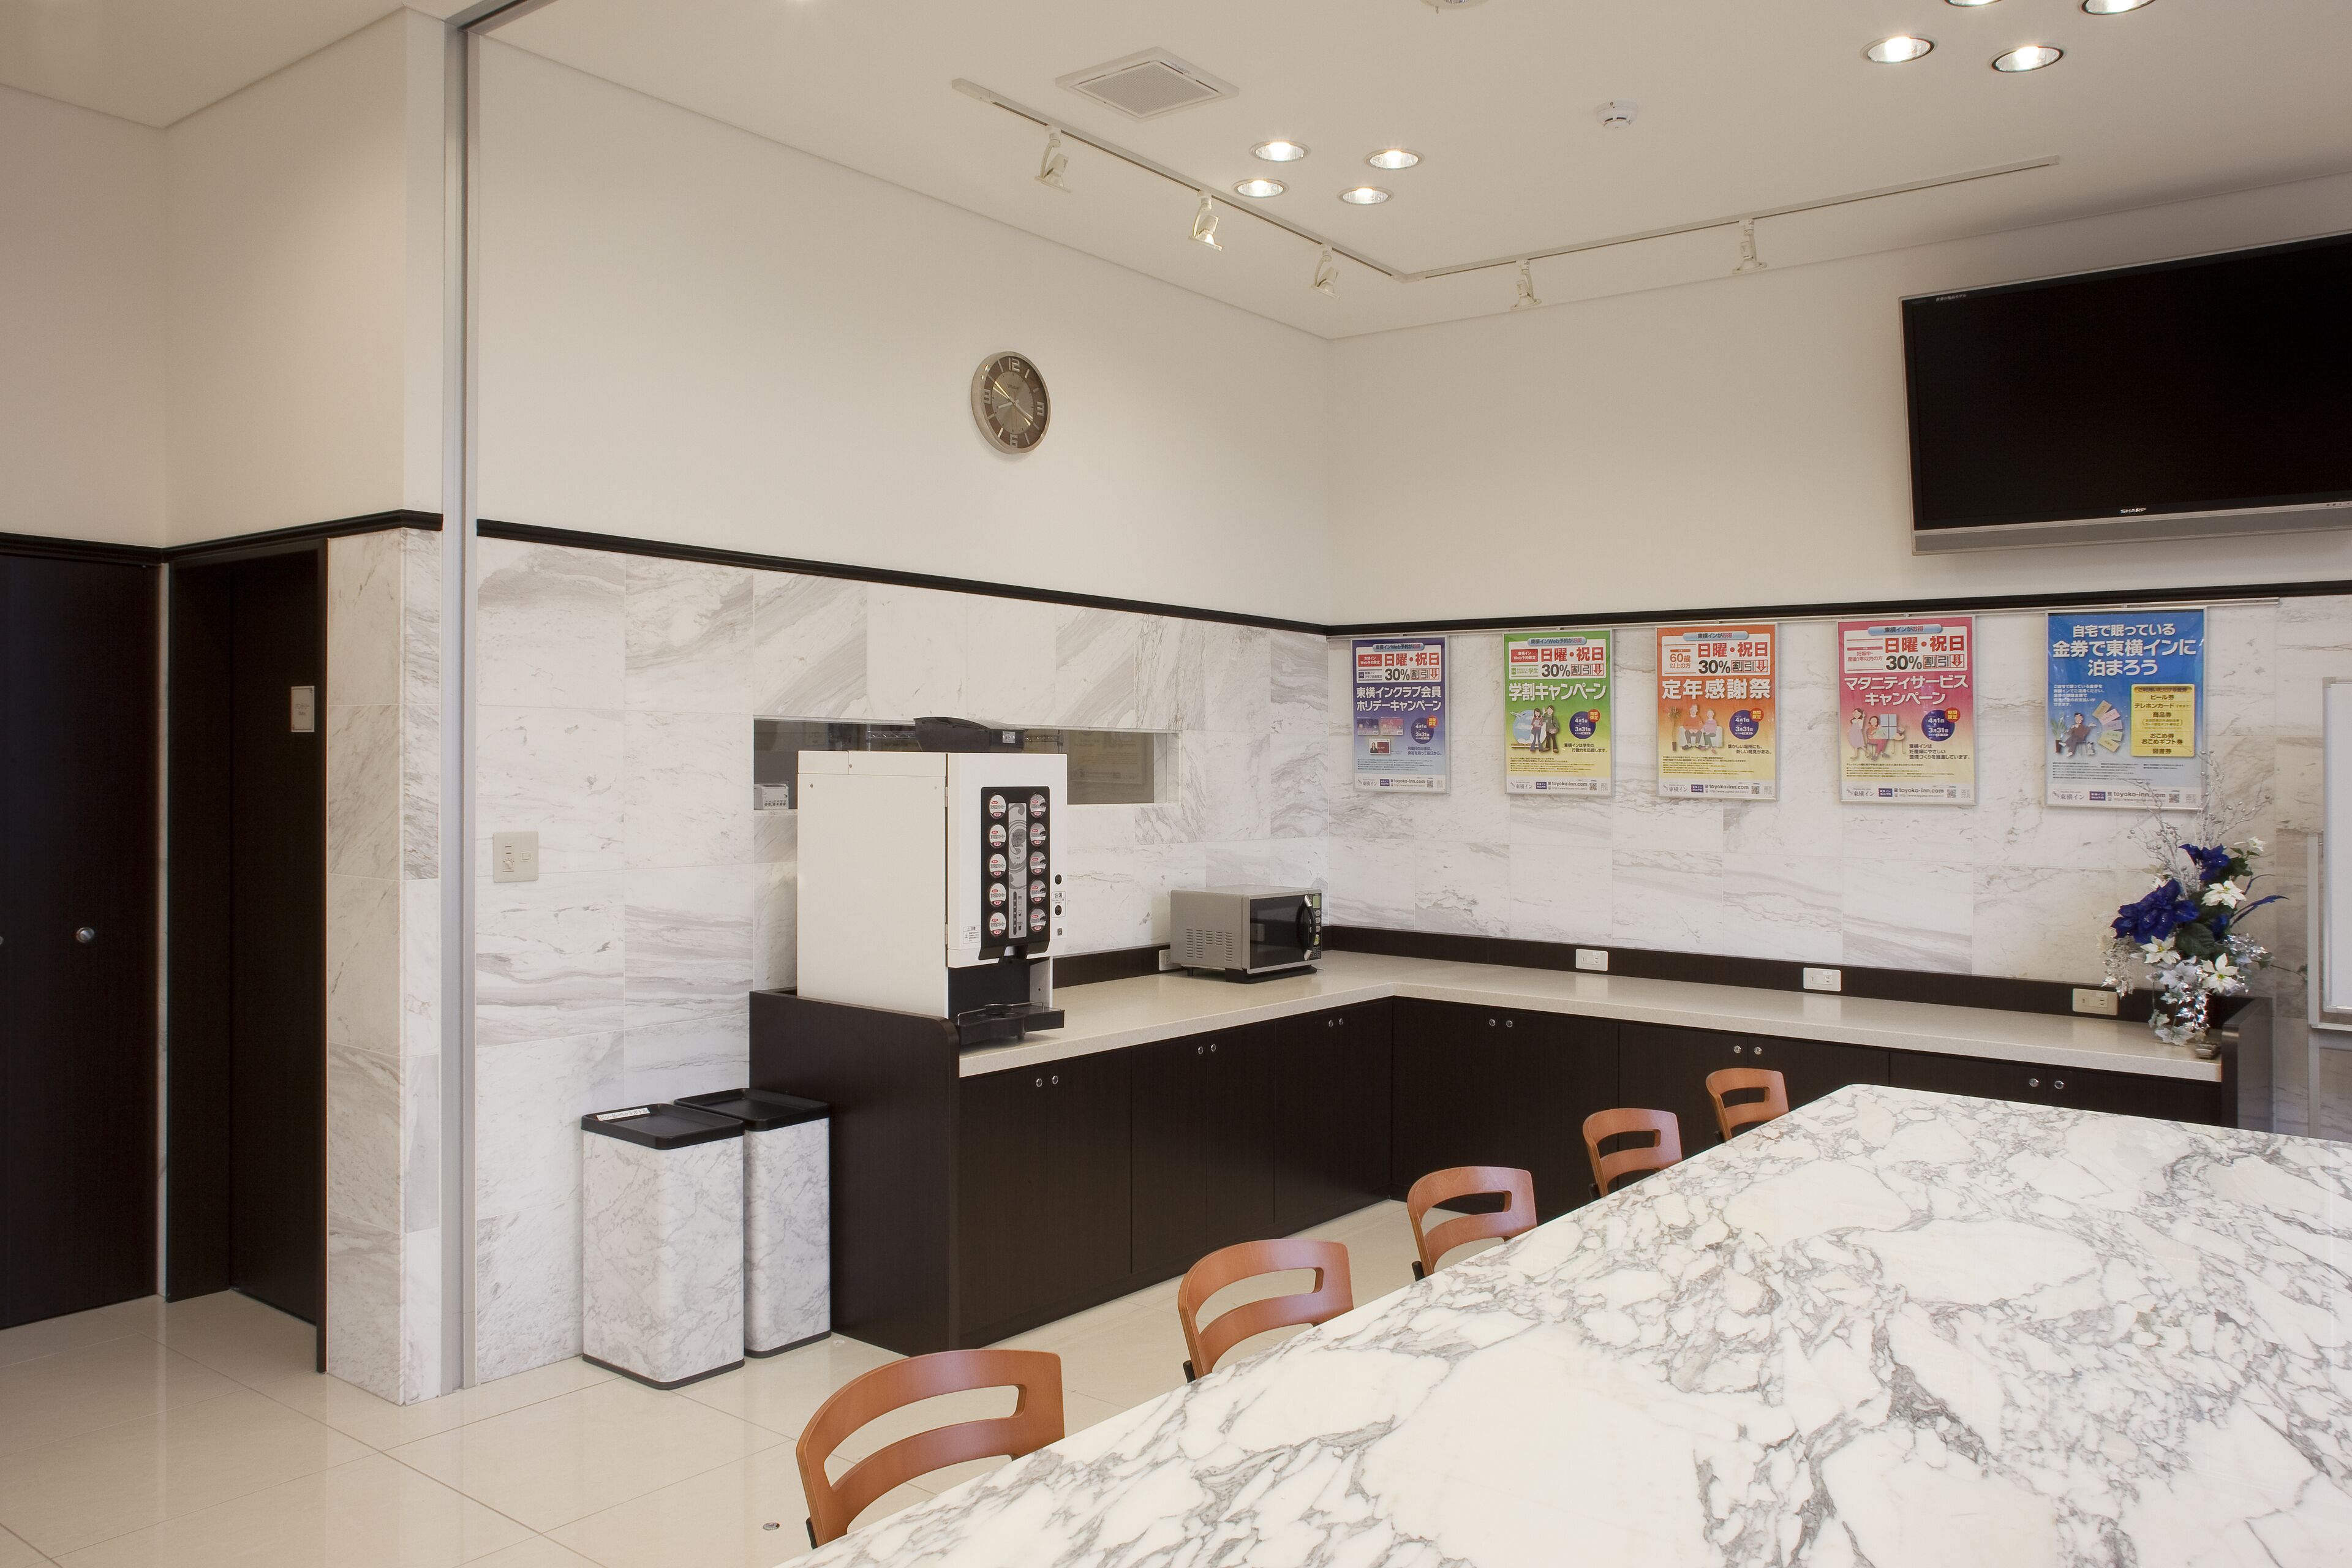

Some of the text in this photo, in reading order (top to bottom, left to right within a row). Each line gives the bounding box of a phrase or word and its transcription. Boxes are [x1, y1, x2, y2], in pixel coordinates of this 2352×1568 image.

[1008, 358, 1020, 372] 12
[1037, 401, 1045, 417] 3
[2073, 624, 2176, 638] 自宅で眠っている
[1698, 642, 1768, 657] 日曜・祝日
[1885, 636, 1964, 653] 日曜・祝日
[2052, 639, 2196, 658] 金券で東横インに
[1384, 652, 1439, 666] 日曜・祝日
[1541, 647, 1604, 662] 日曜・祝日
[1670, 653, 1691, 662] 60歳
[2087, 659, 2158, 676] 泊まろう
[1662, 678, 1771, 699] 定年感謝祭
[1844, 674, 1969, 690] マタニティサービス
[1356, 686, 1442, 698] 東横インクラブ会員
[1509, 682, 1607, 701] 学割キャンペーン
[1865, 692, 1946, 706] キャンペーン
[1356, 699, 1442, 711] ホリデーキャンペーン
